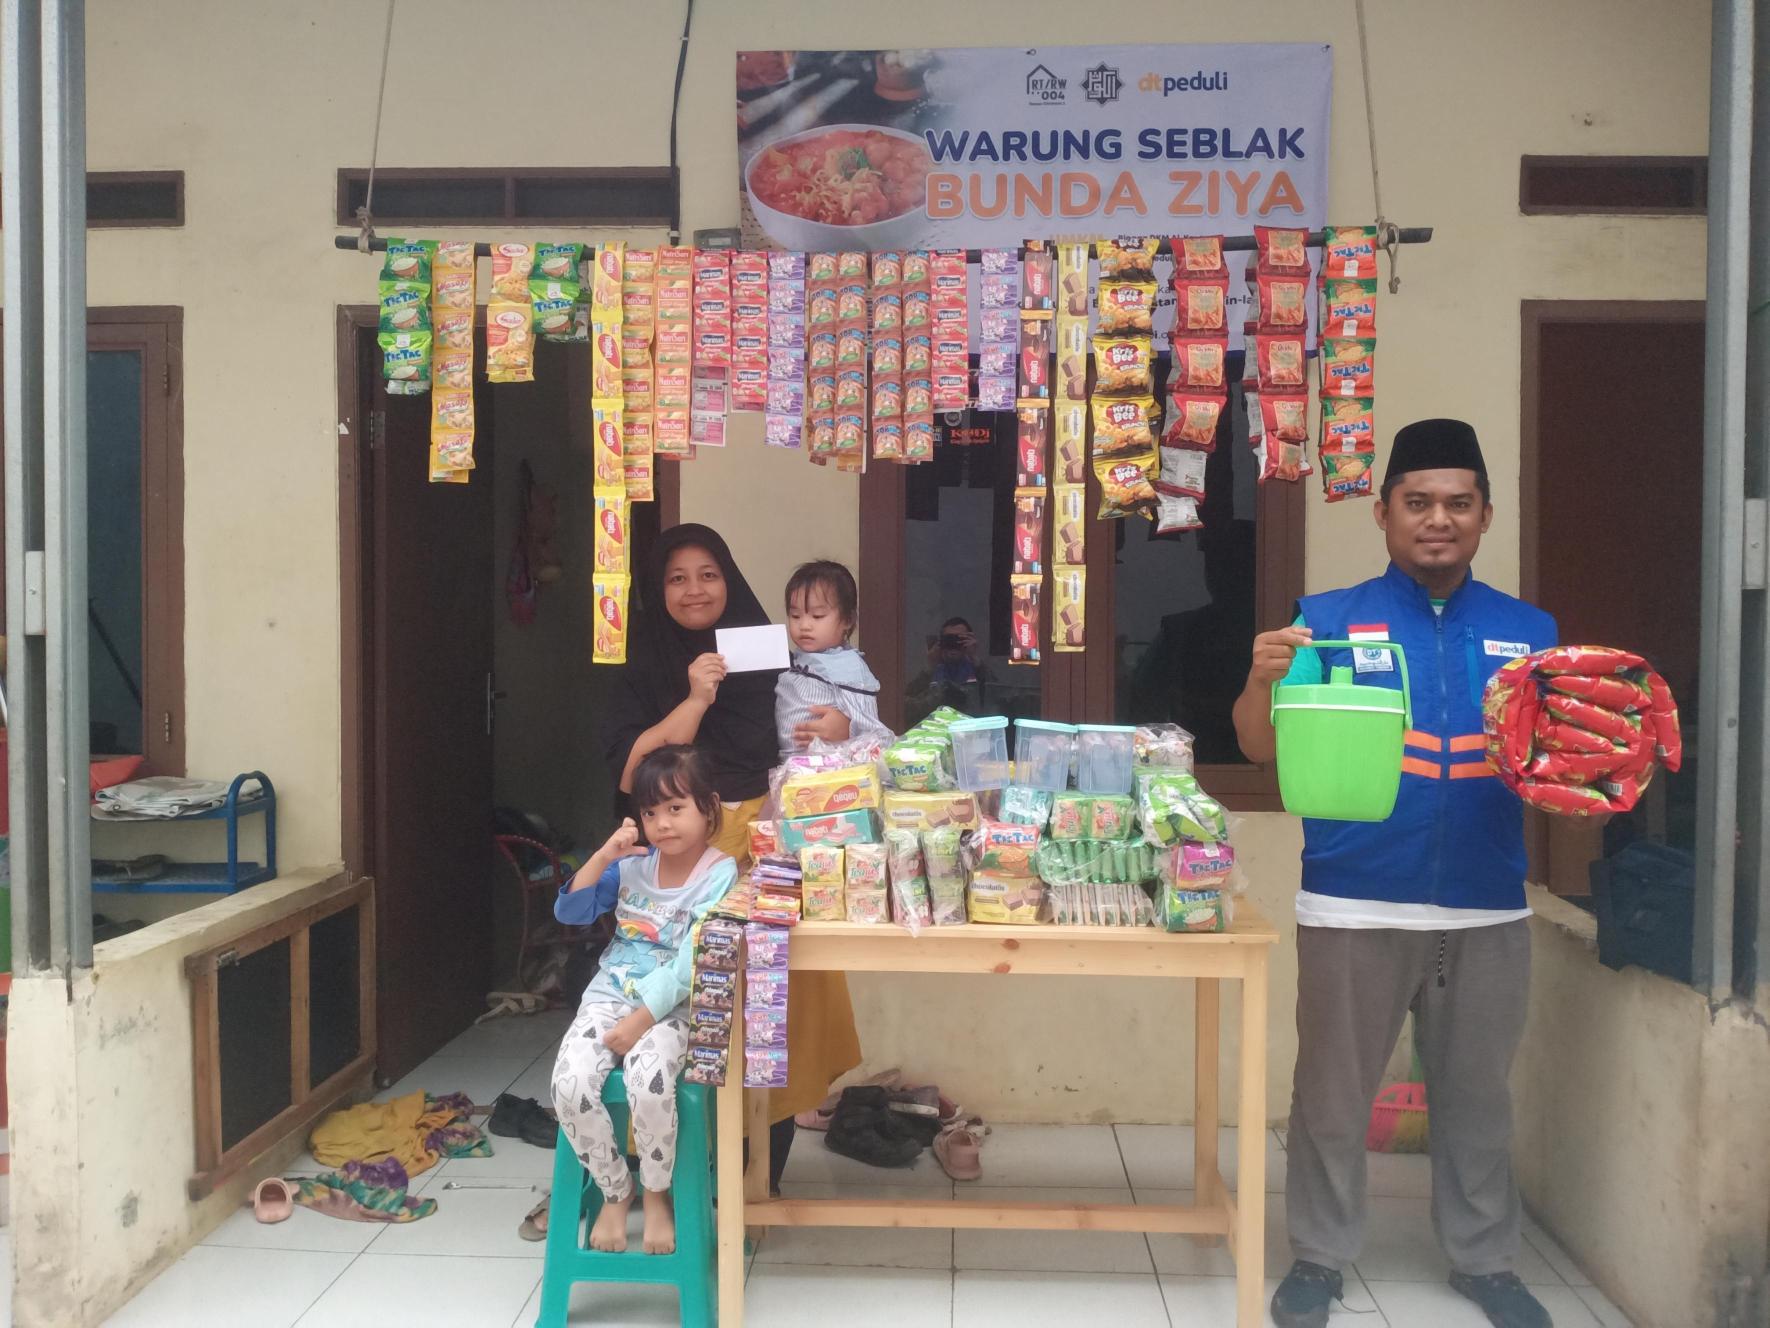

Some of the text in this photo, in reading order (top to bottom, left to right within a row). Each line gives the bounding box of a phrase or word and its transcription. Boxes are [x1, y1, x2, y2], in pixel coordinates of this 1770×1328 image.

[1031, 78, 1067, 90] RT/RW
[1041, 90, 1065, 101] 004
[925, 127, 1305, 162] WARUNG SEBLAK
[926, 169, 1305, 218] BUNDA ZIYA
[1112, 352, 1134, 364] Bee
[1114, 411, 1136, 423] Bee
[706, 934, 731, 945] Marimas
[701, 972, 728, 983] Marimas
[697, 1013, 723, 1023] Marimas
[694, 1049, 720, 1060] Marimas
